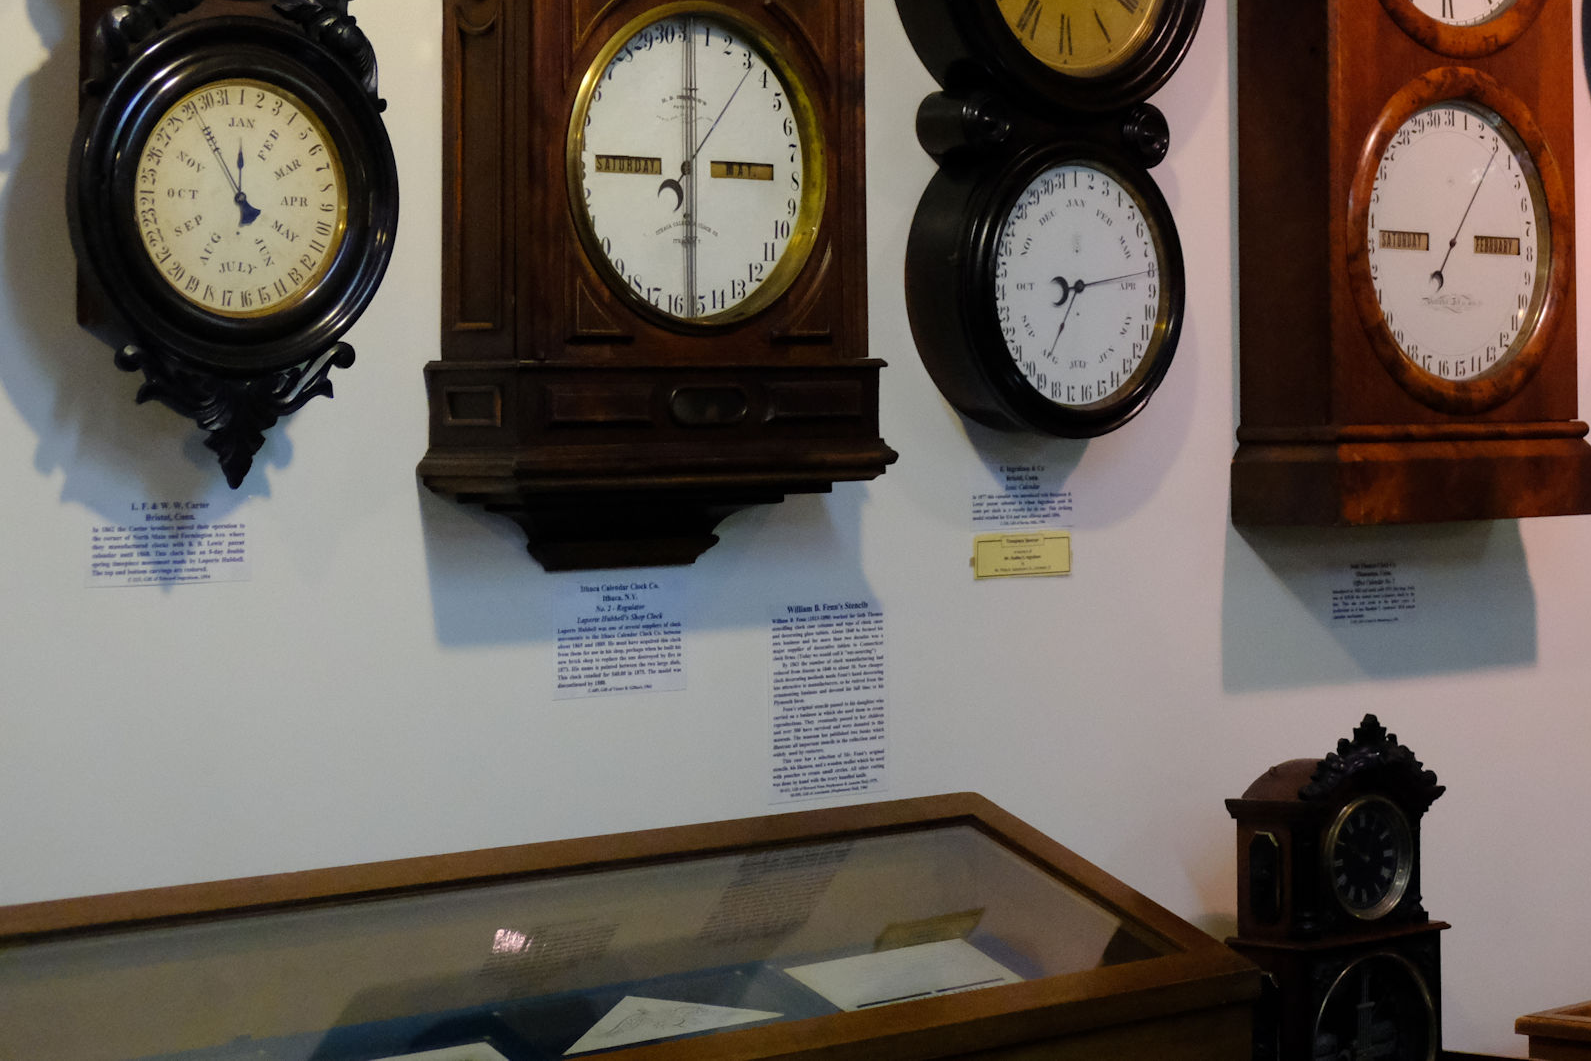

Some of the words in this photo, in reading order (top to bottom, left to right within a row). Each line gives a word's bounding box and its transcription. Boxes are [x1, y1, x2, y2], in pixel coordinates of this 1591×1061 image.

[655, 24, 676, 43] 30
[723, 35, 733, 55] 2
[743, 51, 752, 69] 3
[758, 70, 769, 89] 4
[198, 93, 214, 109] 30
[216, 90, 229, 106] 31
[255, 92, 265, 109] 2
[773, 93, 782, 112] 5
[272, 100, 283, 116] 3
[228, 117, 255, 129] JAN
[783, 117, 793, 136] 6
[1427, 111, 1440, 129] 30
[1444, 109, 1455, 127] 31
[156, 127, 171, 148] 27
[300, 127, 313, 140] 5
[1478, 123, 1485, 139] 2
[257, 129, 280, 161] FEB
[309, 144, 323, 156] 6
[1492, 137, 1499, 152] 3
[147, 147, 163, 165] 26
[177, 150, 205, 174] NOV
[788, 144, 798, 163] 7
[273, 158, 302, 181] MAR
[316, 162, 330, 173] 7
[141, 168, 157, 185] 25
[791, 172, 800, 192] 8
[1055, 173, 1066, 189] 31
[1088, 173, 1095, 190] 2
[167, 188, 198, 200] OCT
[1041, 179, 1054, 195] 30
[1102, 180, 1109, 196] 3
[280, 196, 308, 207] APR
[788, 198, 796, 218] 9
[1066, 199, 1086, 207] JAN
[1521, 198, 1528, 212] 6
[174, 214, 203, 237] SEP
[272, 220, 300, 243] MAY
[775, 220, 790, 240] 10
[1137, 222, 1143, 238] 6
[156, 246, 172, 264] 21
[199, 232, 222, 265] AUG
[764, 243, 776, 262] 11
[1527, 247, 1533, 263] 8
[219, 261, 257, 274] JULY
[300, 254, 316, 271] 12
[1148, 262, 1154, 278] 8
[167, 262, 185, 282] 20
[288, 268, 304, 285] 13
[748, 263, 764, 283] 12
[185, 275, 200, 293] 19
[731, 280, 746, 300] 13
[1016, 283, 1034, 291] OCT
[1149, 283, 1155, 299] 9
[203, 285, 215, 302] 18
[222, 290, 233, 307] 17
[241, 290, 252, 308] 16
[258, 287, 271, 305] 15
[648, 288, 662, 309] 17
[711, 290, 726, 309] 14
[1518, 294, 1528, 309] 10
[668, 294, 684, 315] 16
[1500, 332, 1510, 348] 12
[1132, 342, 1142, 359] 12
[1486, 347, 1496, 362] 13
[1422, 355, 1432, 371] 17
[1438, 360, 1449, 376] 16
[1051, 382, 1062, 398] 18
[1081, 386, 1092, 401] 16
[581, 585, 600, 593] Ithaca
[617, 604, 645, 612] Regulator
[787, 605, 812, 613] William
